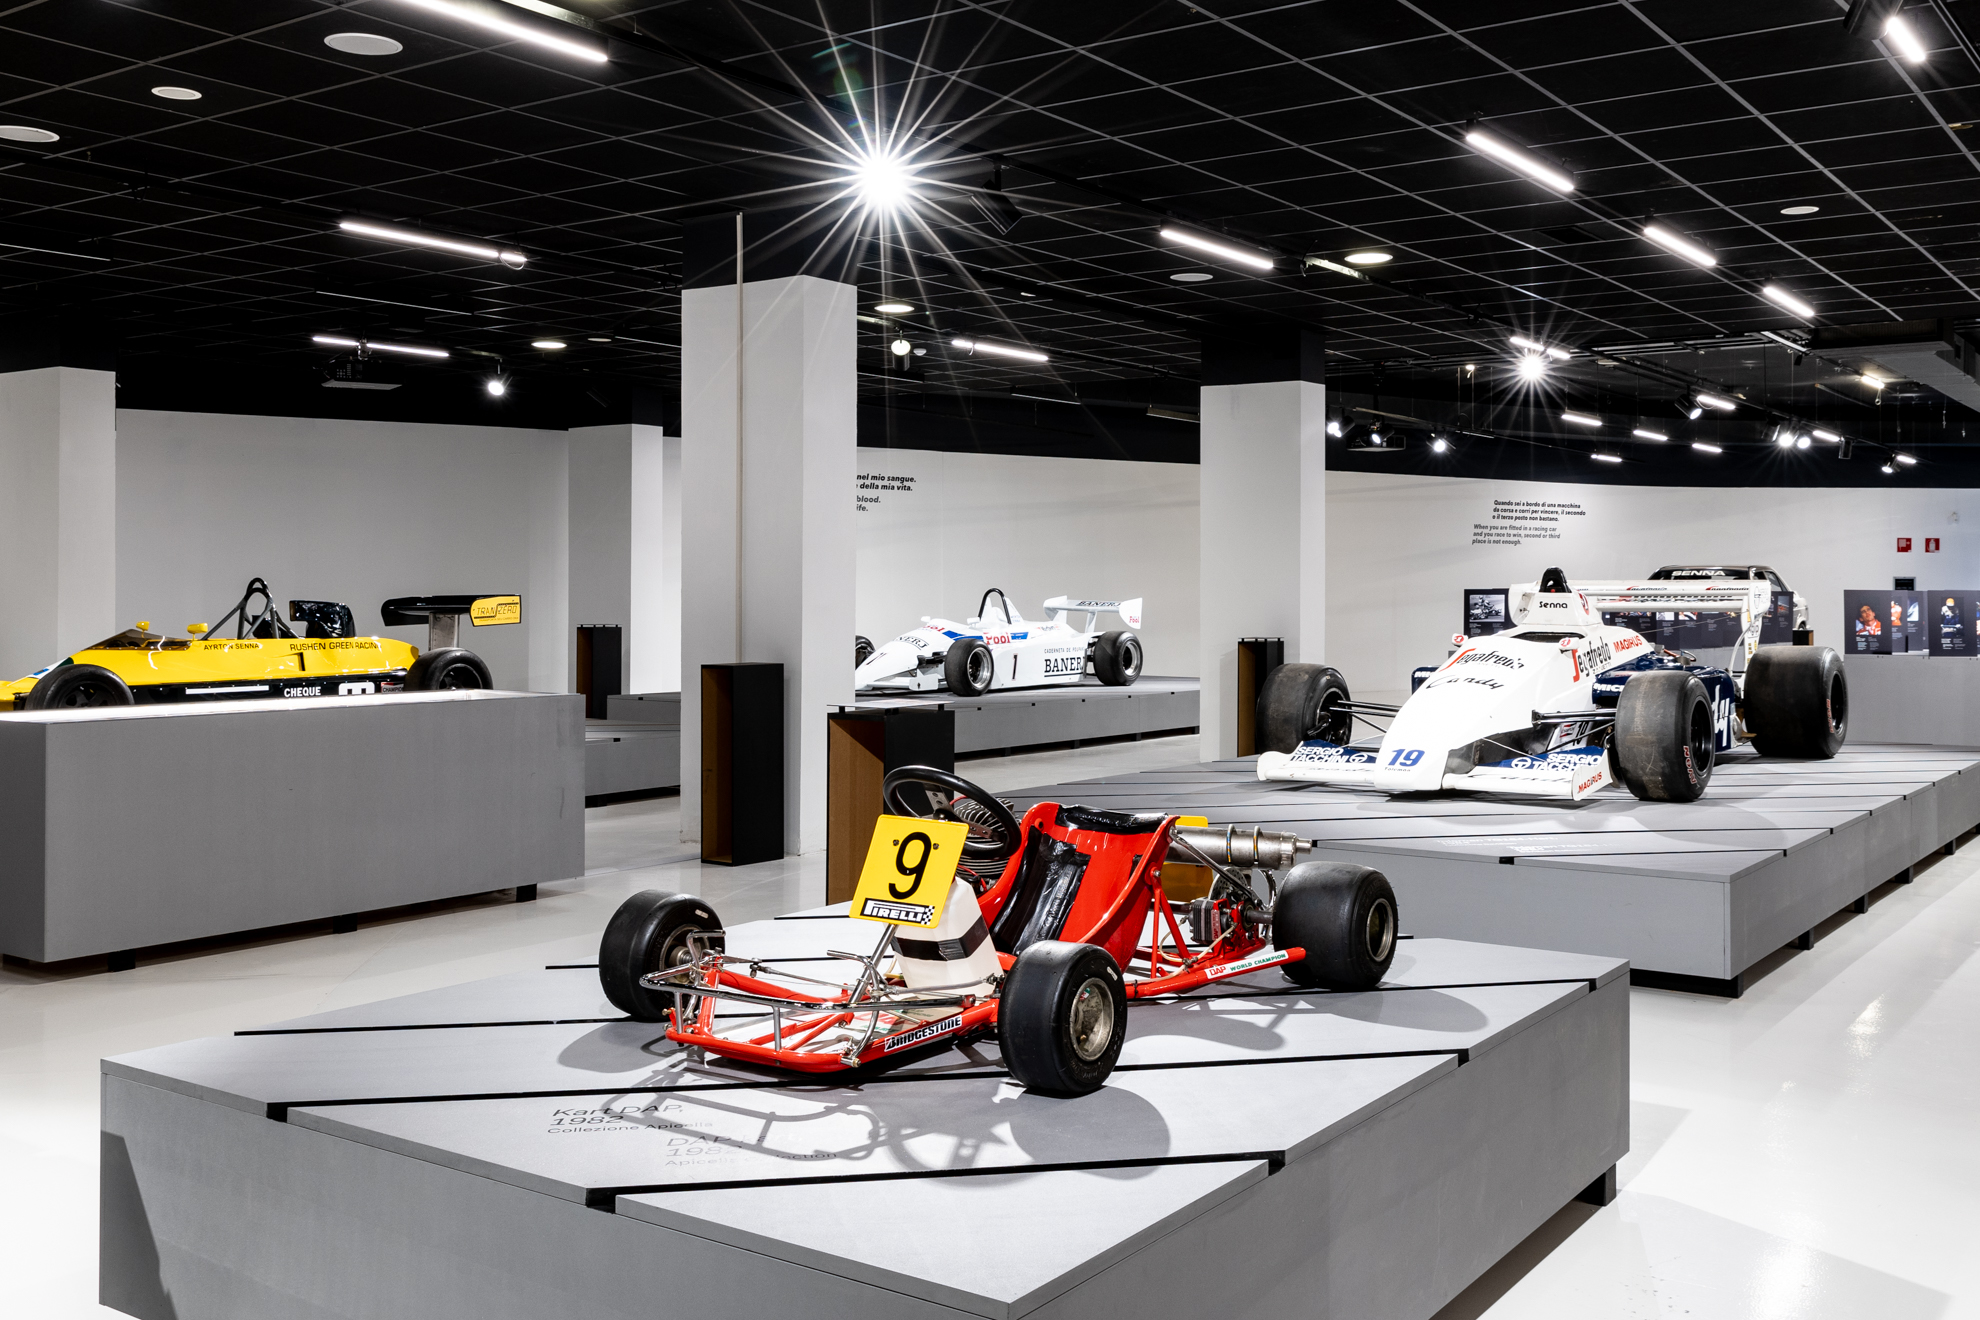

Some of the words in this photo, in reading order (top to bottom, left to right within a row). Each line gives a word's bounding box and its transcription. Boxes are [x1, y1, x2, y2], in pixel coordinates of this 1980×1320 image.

[887, 475, 916, 484] sangue.
[860, 482, 879, 490] della
[857, 495, 881, 503] blood.
[1538, 601, 1568, 609] Senna
[289, 643, 326, 651] RUSHEN
[328, 642, 354, 650] GREEN
[1613, 635, 1643, 653] MAGIRUS
[1012, 653, 1018, 680] 1
[283, 686, 321, 697] CHEQUE
[1297, 746, 1344, 755] SERGIO
[1291, 754, 1350, 763] TACCHINI
[1387, 748, 1425, 767] 19
[1547, 753, 1601, 765] SERGIO
[1577, 771, 1603, 793] MAGIRUS
[888, 831, 932, 900] 9
[863, 900, 926, 922] PIRELLI
[1208, 966, 1227, 976] DAP
[1230, 962, 1253, 971] WORLD
[1254, 953, 1286, 965] CHAMPION
[885, 1016, 962, 1050] BRIDGESTONE
[553, 1107, 612, 1117] Kart
[550, 1115, 624, 1126] 1982
[548, 1125, 639, 1134] Collezione
[645, 1122, 713, 1130] Apicella
